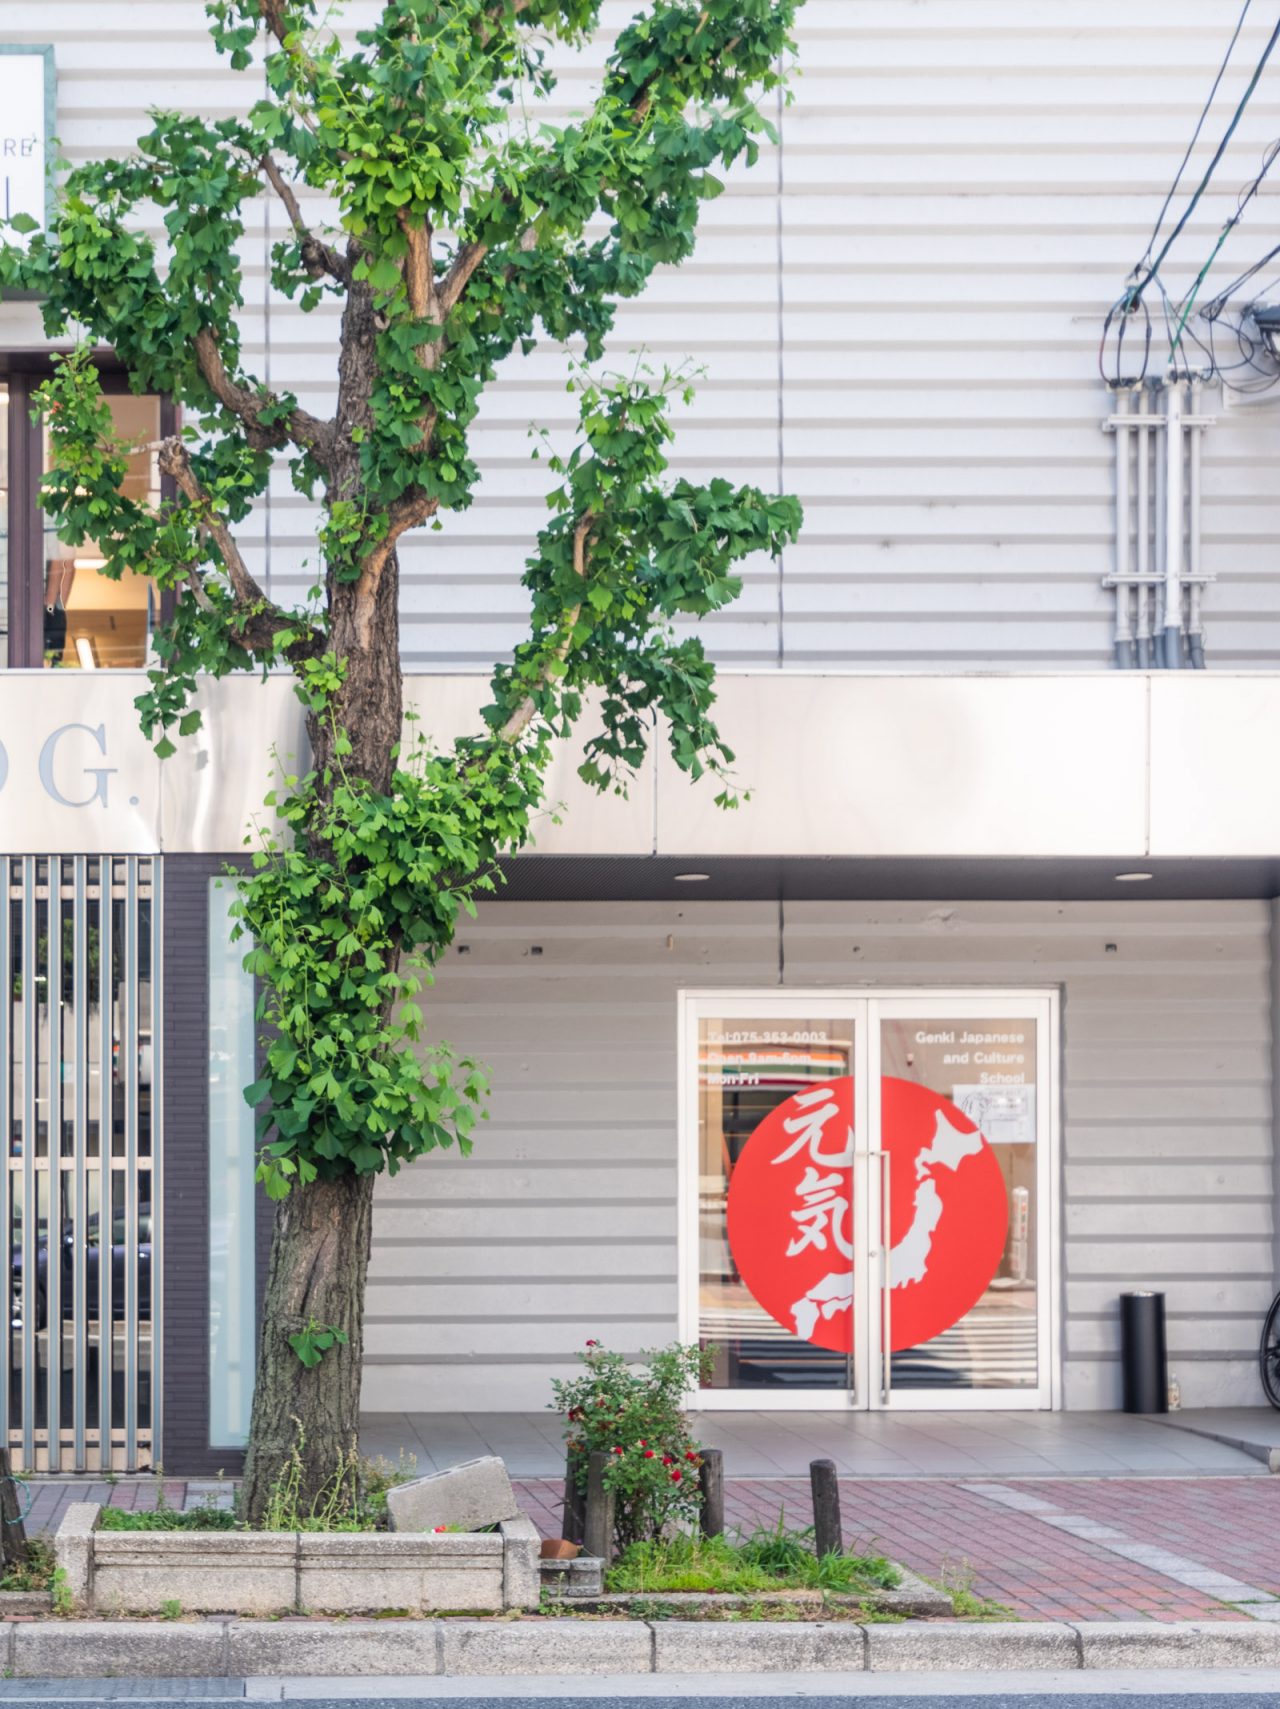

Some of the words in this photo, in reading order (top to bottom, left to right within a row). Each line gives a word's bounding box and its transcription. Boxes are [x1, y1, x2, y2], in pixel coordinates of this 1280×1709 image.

[915, 1031, 955, 1044] Genki
[959, 1031, 1025, 1045] Japanese
[943, 1052, 969, 1064] and
[974, 1052, 1025, 1064] Culture
[980, 1072, 1025, 1083] School
[770, 1088, 856, 1261] 元気
